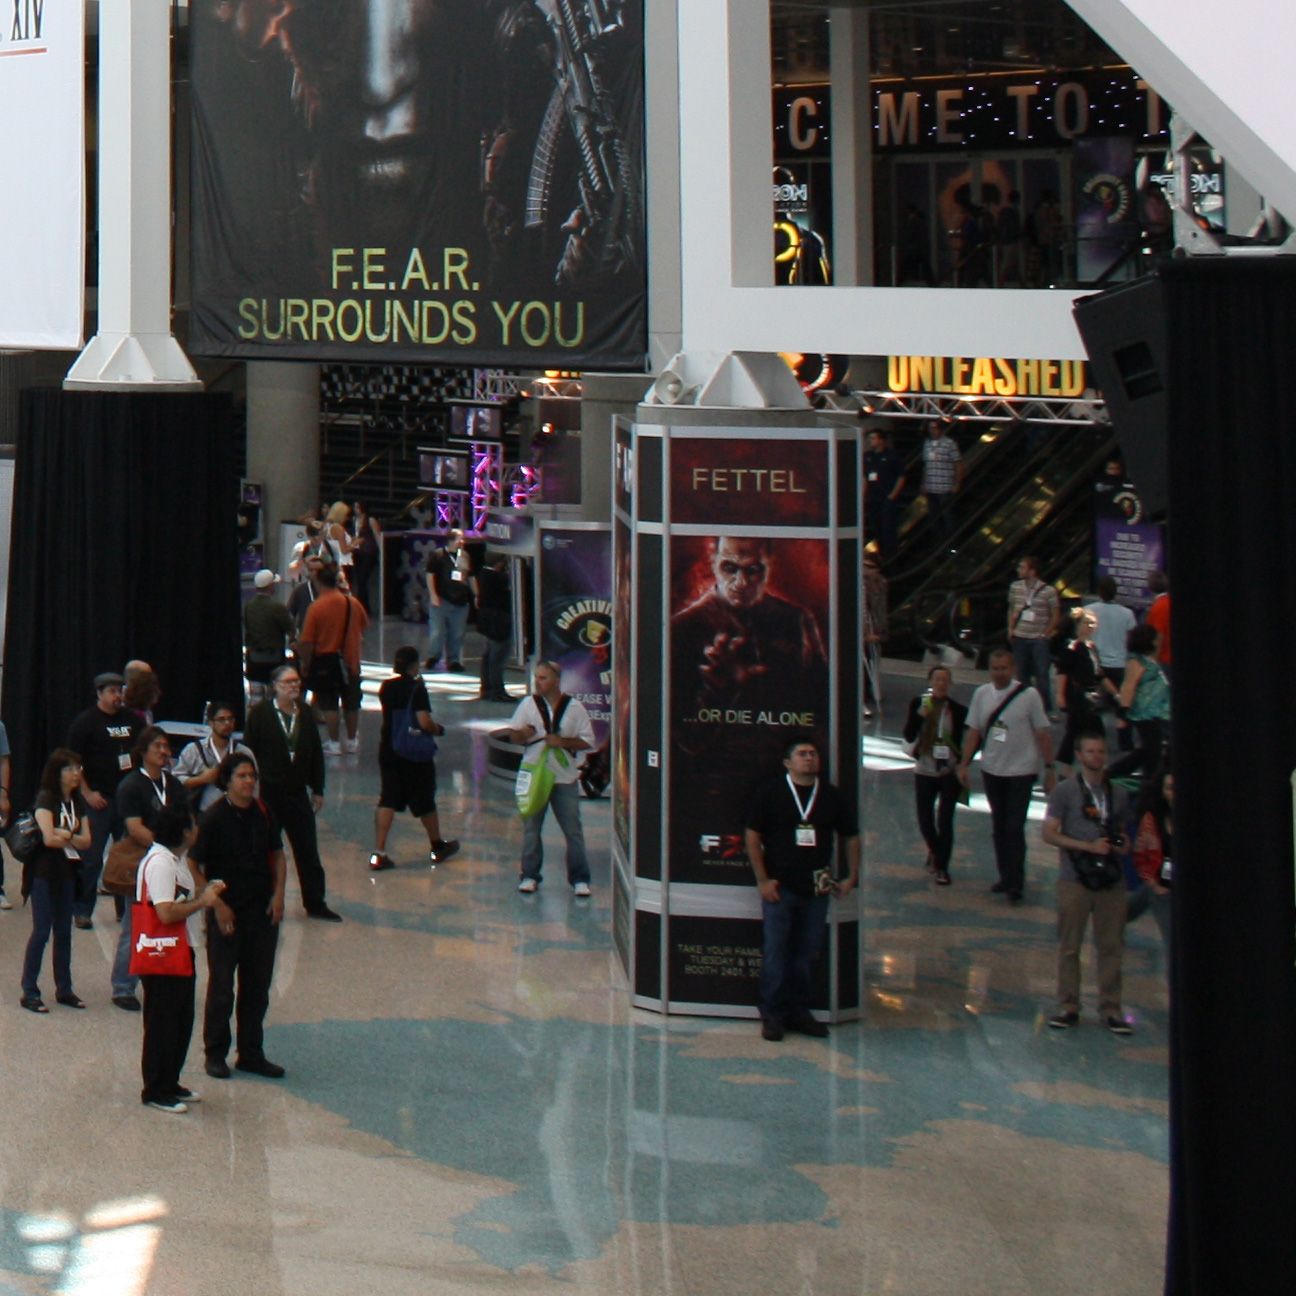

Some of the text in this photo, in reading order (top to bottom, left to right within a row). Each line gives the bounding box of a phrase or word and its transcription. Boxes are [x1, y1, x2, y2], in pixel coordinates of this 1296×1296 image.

[1007, 82, 1089, 141] TO
[331, 248, 480, 291] F.E.A.R.
[238, 297, 585, 347] SURROUNDS YOU
[887, 356, 1086, 397] UNLEASHED
[692, 468, 806, 493] FETTEL
[725, 709, 752, 725] DIE
[756, 710, 815, 727] ALONE
